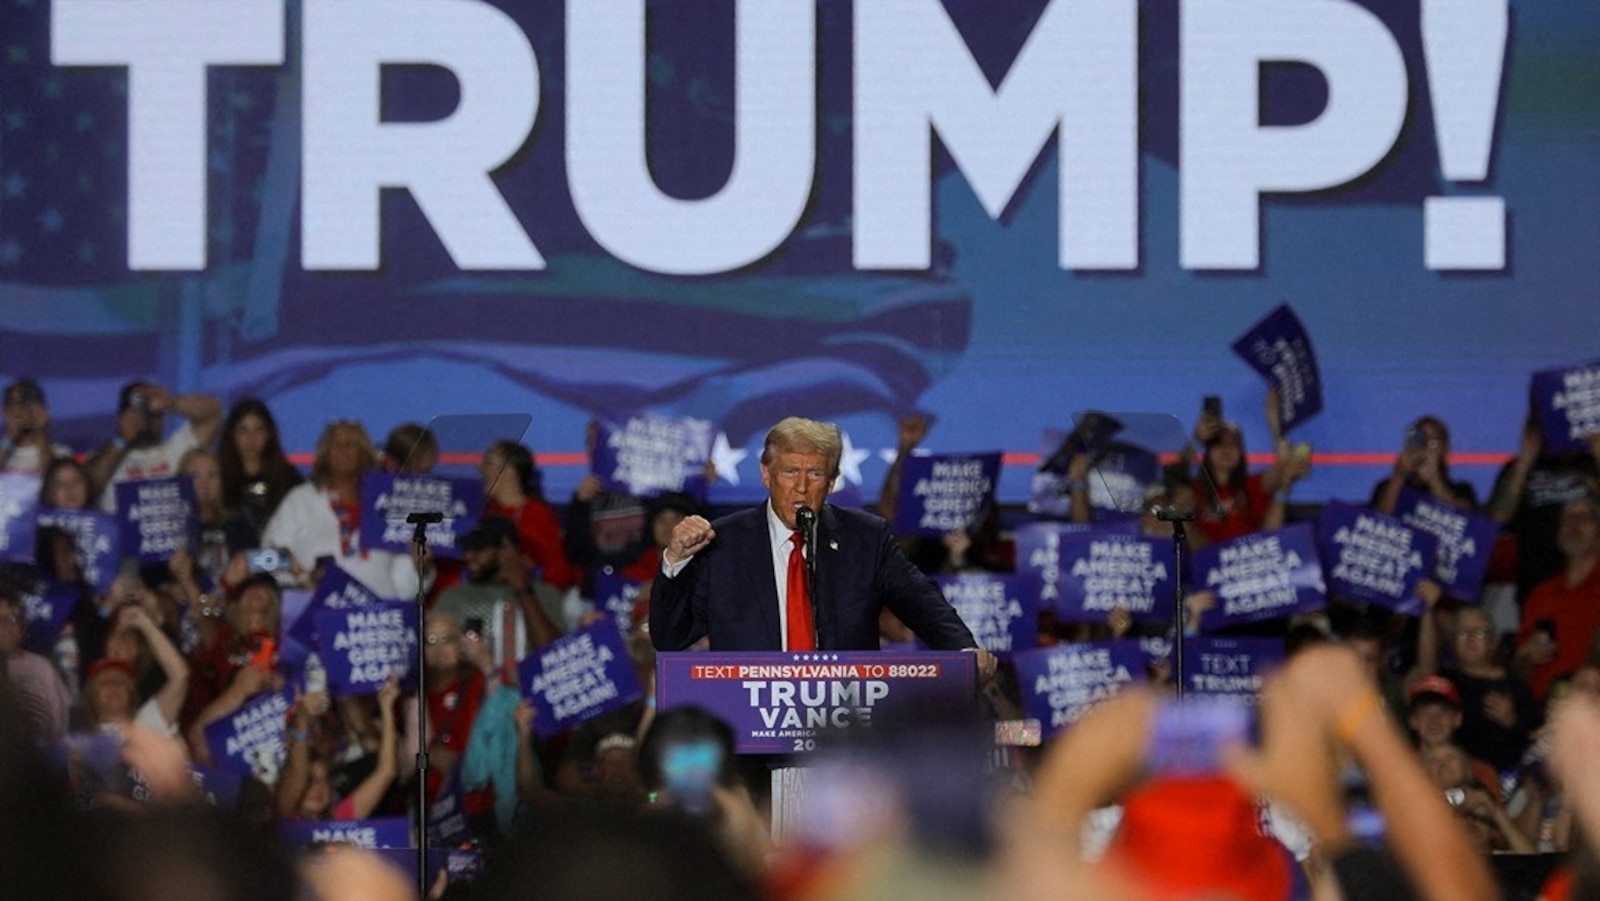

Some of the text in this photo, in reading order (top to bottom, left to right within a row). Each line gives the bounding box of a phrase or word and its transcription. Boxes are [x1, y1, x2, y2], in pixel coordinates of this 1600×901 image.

[51, 0, 1508, 274] TRUMP!
[932, 461, 984, 478] MAKE
[392, 479, 452, 497] MAKE
[374, 493, 468, 518] AMERICA
[1355, 515, 1414, 548] MAKE
[1089, 541, 1152, 558] MAKE
[1219, 536, 1281, 562] MAKE
[1333, 526, 1423, 569] AMERICA
[1071, 557, 1168, 580] AMERICA
[1207, 549, 1302, 587] AMERICA
[1340, 548, 1410, 578] GREAT
[1084, 575, 1156, 595] GREAT
[347, 609, 403, 629] MAKE
[333, 626, 418, 650] AMERICA
[541, 634, 594, 671] MAKE
[1048, 649, 1111, 674] MAKE
[1200, 653, 1251, 675] TEXT
[531, 645, 614, 695] AMERICA
[695, 665, 937, 679] TEXT PENNSYLVANIA TO 88022
[1034, 664, 1133, 695] AMERICA
[545, 667, 607, 705] GREAT
[742, 681, 890, 708] TRUMP
[1192, 674, 1264, 692] TRUMP
[233, 693, 287, 732] MAKE
[759, 707, 872, 728] VANCE
[752, 730, 817, 738] MAKE AMERICA
[312, 826, 377, 845] MAKE
